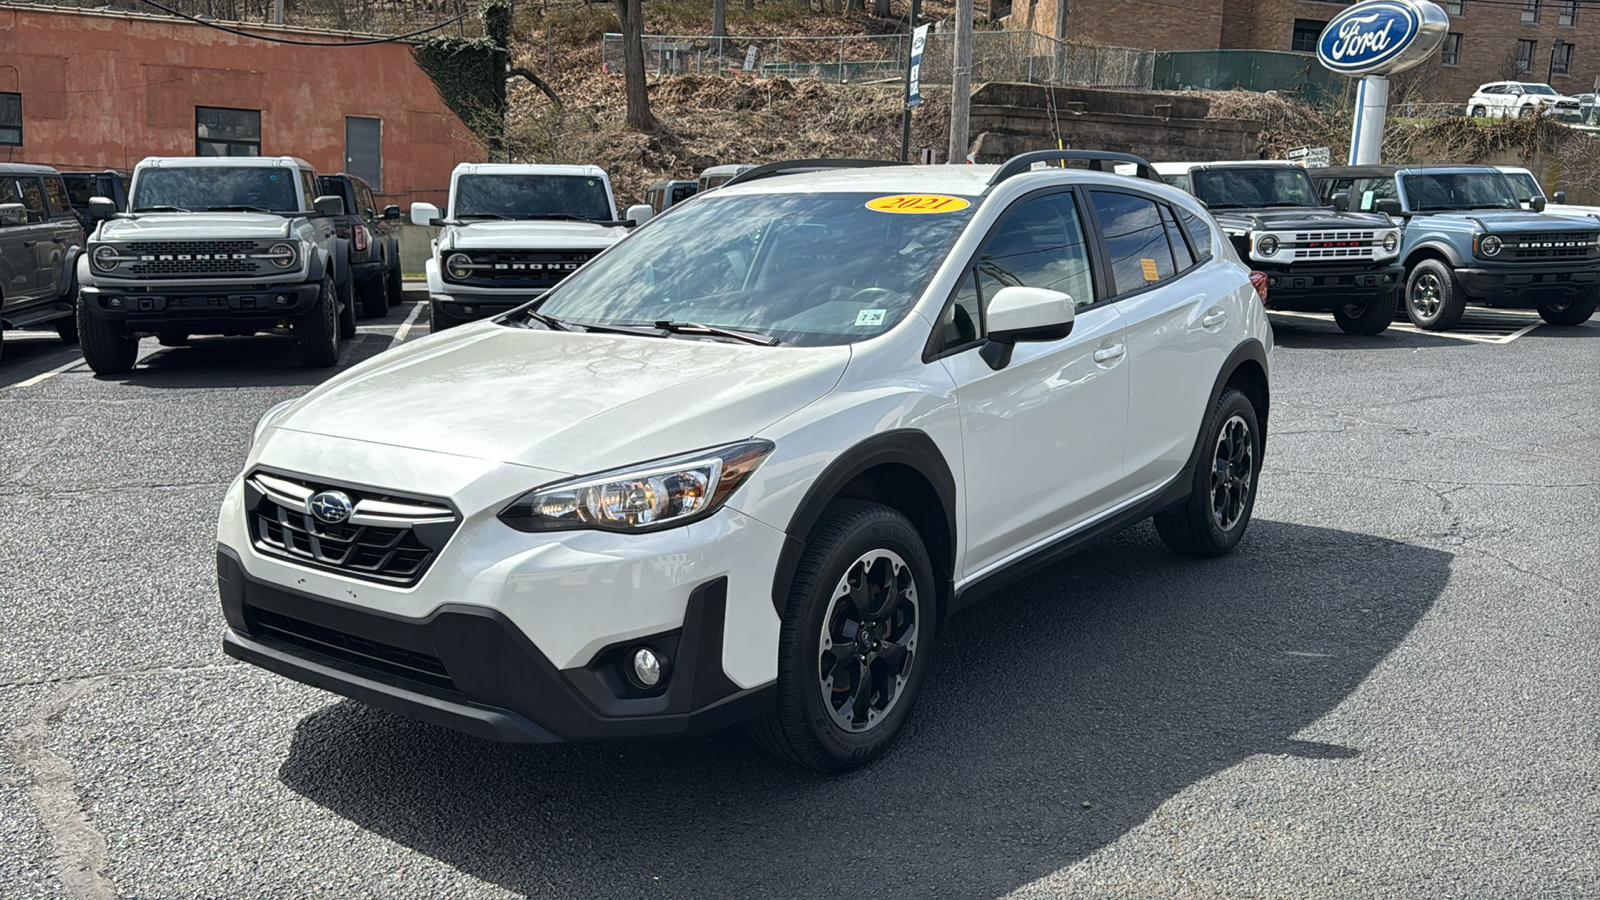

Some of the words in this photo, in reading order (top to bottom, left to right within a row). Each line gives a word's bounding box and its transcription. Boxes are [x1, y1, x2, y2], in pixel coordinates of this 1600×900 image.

[1332, 13, 1395, 60] Ford
[879, 197, 954, 209] 2021
[141, 253, 246, 261] BRONCO
[871, 313, 882, 321] 26
